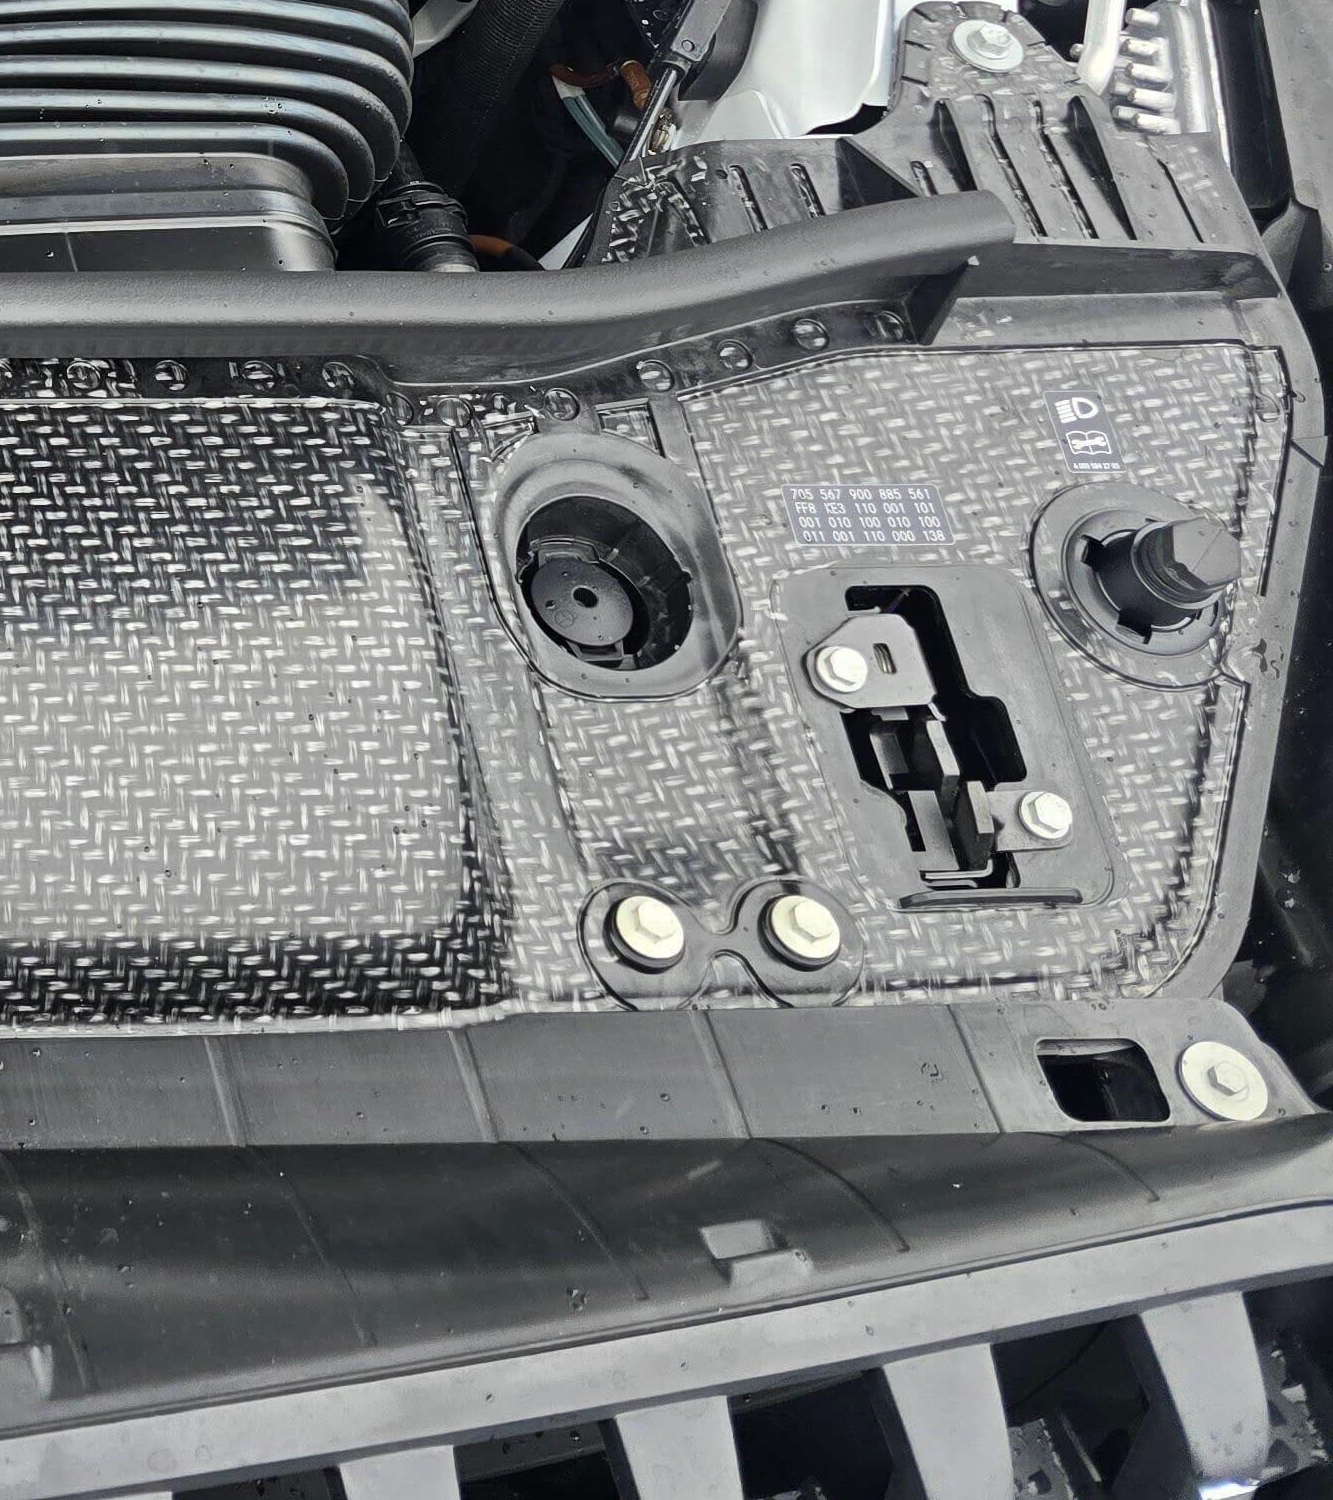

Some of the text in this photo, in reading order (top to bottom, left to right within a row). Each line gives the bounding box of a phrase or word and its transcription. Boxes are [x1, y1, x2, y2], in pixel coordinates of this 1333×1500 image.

[789, 488, 932, 501] 705 567 900 885 561
[794, 502, 817, 515] FF8
[854, 502, 877, 515] 110
[883, 502, 906, 515] 001
[913, 502, 935, 515] 101
[798, 516, 942, 529] 001 010 100 010 100
[803, 530, 946, 543] 011 001 110 000 138
